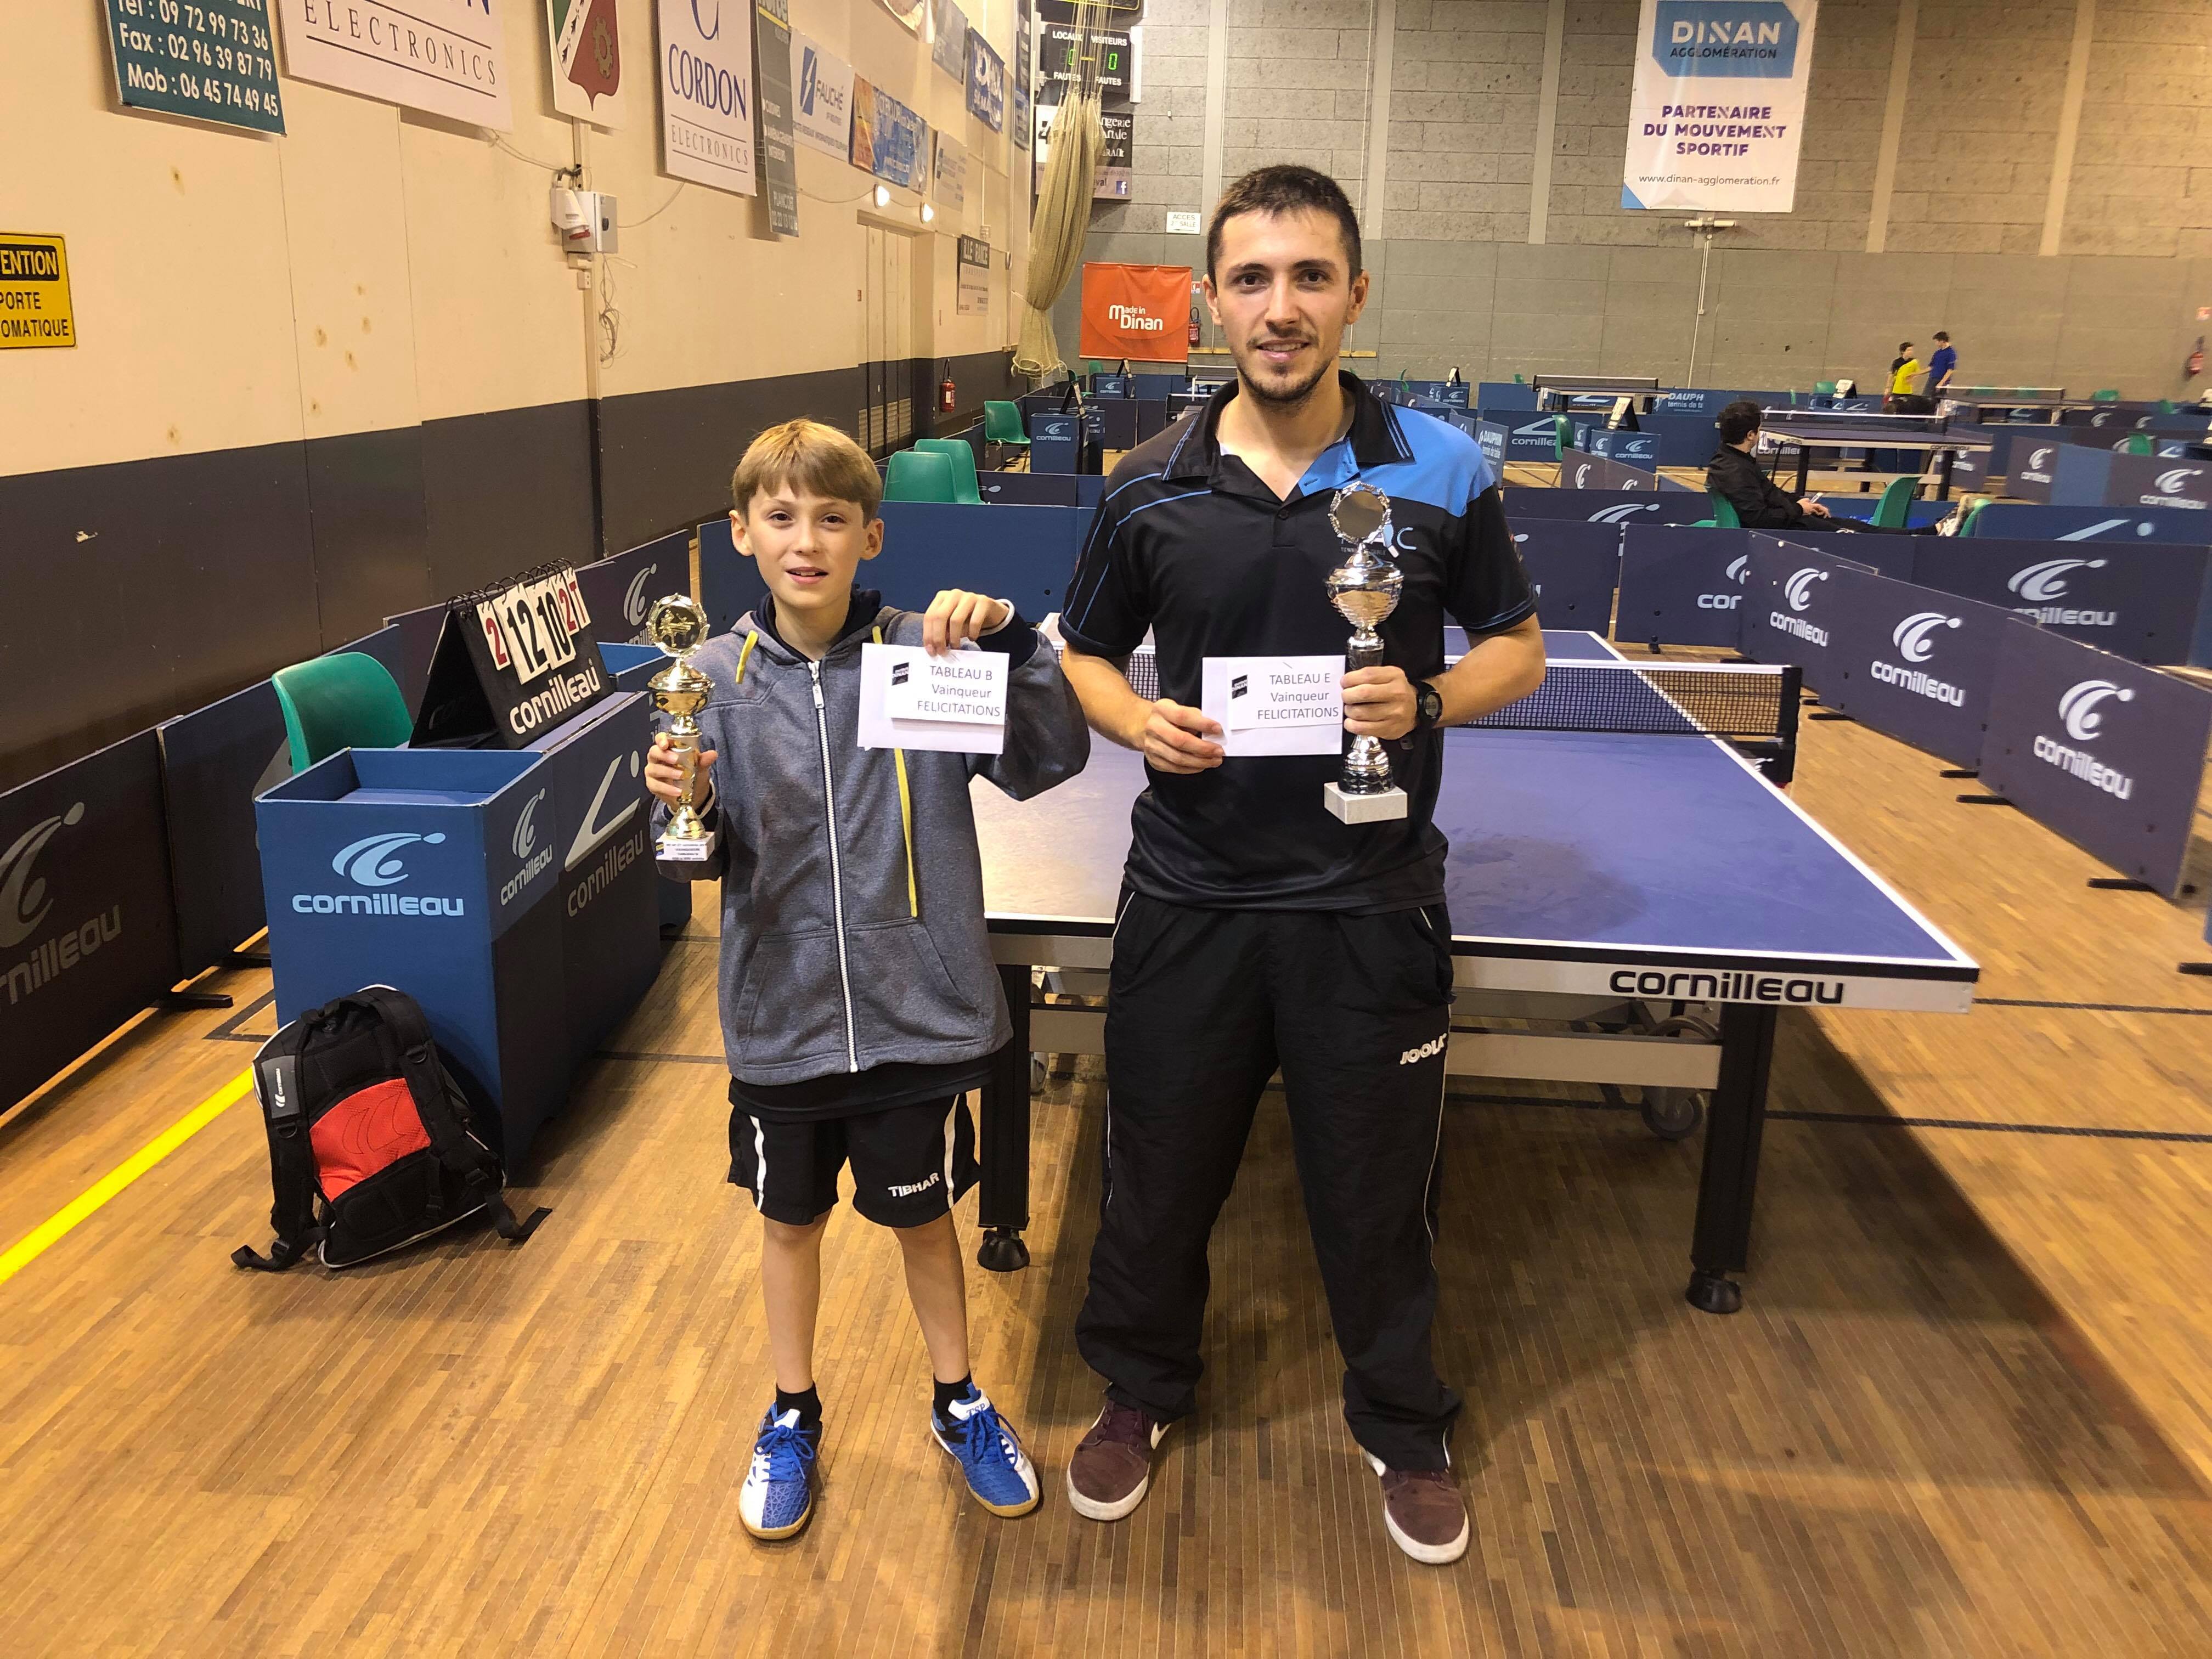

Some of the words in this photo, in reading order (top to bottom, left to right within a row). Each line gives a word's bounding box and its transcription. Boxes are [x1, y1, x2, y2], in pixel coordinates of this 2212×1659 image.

[160, 0, 178, 25] 09
[184, 5, 205, 32] 72
[209, 12, 225, 38] 99
[231, 19, 249, 45] 73
[252, 25, 268, 51] 36
[1671, 21, 1782, 44] DINAN
[304, 0, 496, 85] ELECTRONICS
[1052, 31, 1082, 42] LOCAUX
[1090, 36, 1127, 46] VISITEURS
[119, 22, 154, 53] Fax
[168, 33, 190, 61] 02
[193, 40, 212, 66] 96
[216, 46, 232, 71] 39
[238, 52, 252, 76] 87
[257, 57, 272, 82] 79
[1669, 46, 1778, 59] AGGLOMÉRATION
[128, 62, 167, 93] Mob
[180, 72, 199, 99] 06
[204, 78, 221, 104] 45
[224, 82, 241, 108] 74
[245, 88, 259, 111] 49
[263, 92, 278, 117] 45
[669, 43, 747, 122] CORDON
[1662, 105, 1772, 120] PARTENAIRE
[1643, 123, 1667, 137] DU
[1674, 123, 1787, 139] MOUVEMENT
[671, 124, 748, 166] ELECTRONICS
[1676, 142, 1750, 156] SPORTIF
[1639, 174, 1781, 187] www.dinan-agglomeration.fr
[0, 250, 57, 275] ENTION
[1120, 314, 1163, 330] Dinan
[1138, 306, 1146, 315] in
[1, 319, 69, 337] OMATIQUE
[1668, 392, 1704, 401] DAUPH
[1511, 437, 1556, 446] cornille
[486, 617, 507, 666] 2
[506, 598, 548, 675] 12
[536, 591, 572, 663] 10
[1769, 611, 1829, 648] cornilleau
[930, 665, 981, 680] TABLEAU
[985, 670, 993, 681] B
[1269, 674, 1321, 686] TABLEAU
[1324, 673, 1331, 684] E
[1871, 659, 1966, 708] cornilleau
[510, 664, 601, 734] cornilleau
[932, 684, 992, 699] Vainqueur
[1270, 692, 1329, 704] Vainqueur
[917, 700, 1001, 717] FELICITATIONS
[1257, 707, 1339, 720] FELICITATIONS
[2033, 735, 2133, 801] cornilleau
[500, 844, 552, 906] cornilleau
[567, 830, 644, 918] cornilleau
[292, 893, 465, 916] cornilleau
[0, 904, 122, 1006] nilleau
[1609, 970, 1845, 1005] cornilleau
[887, 1172, 940, 1198] TIBHAR
